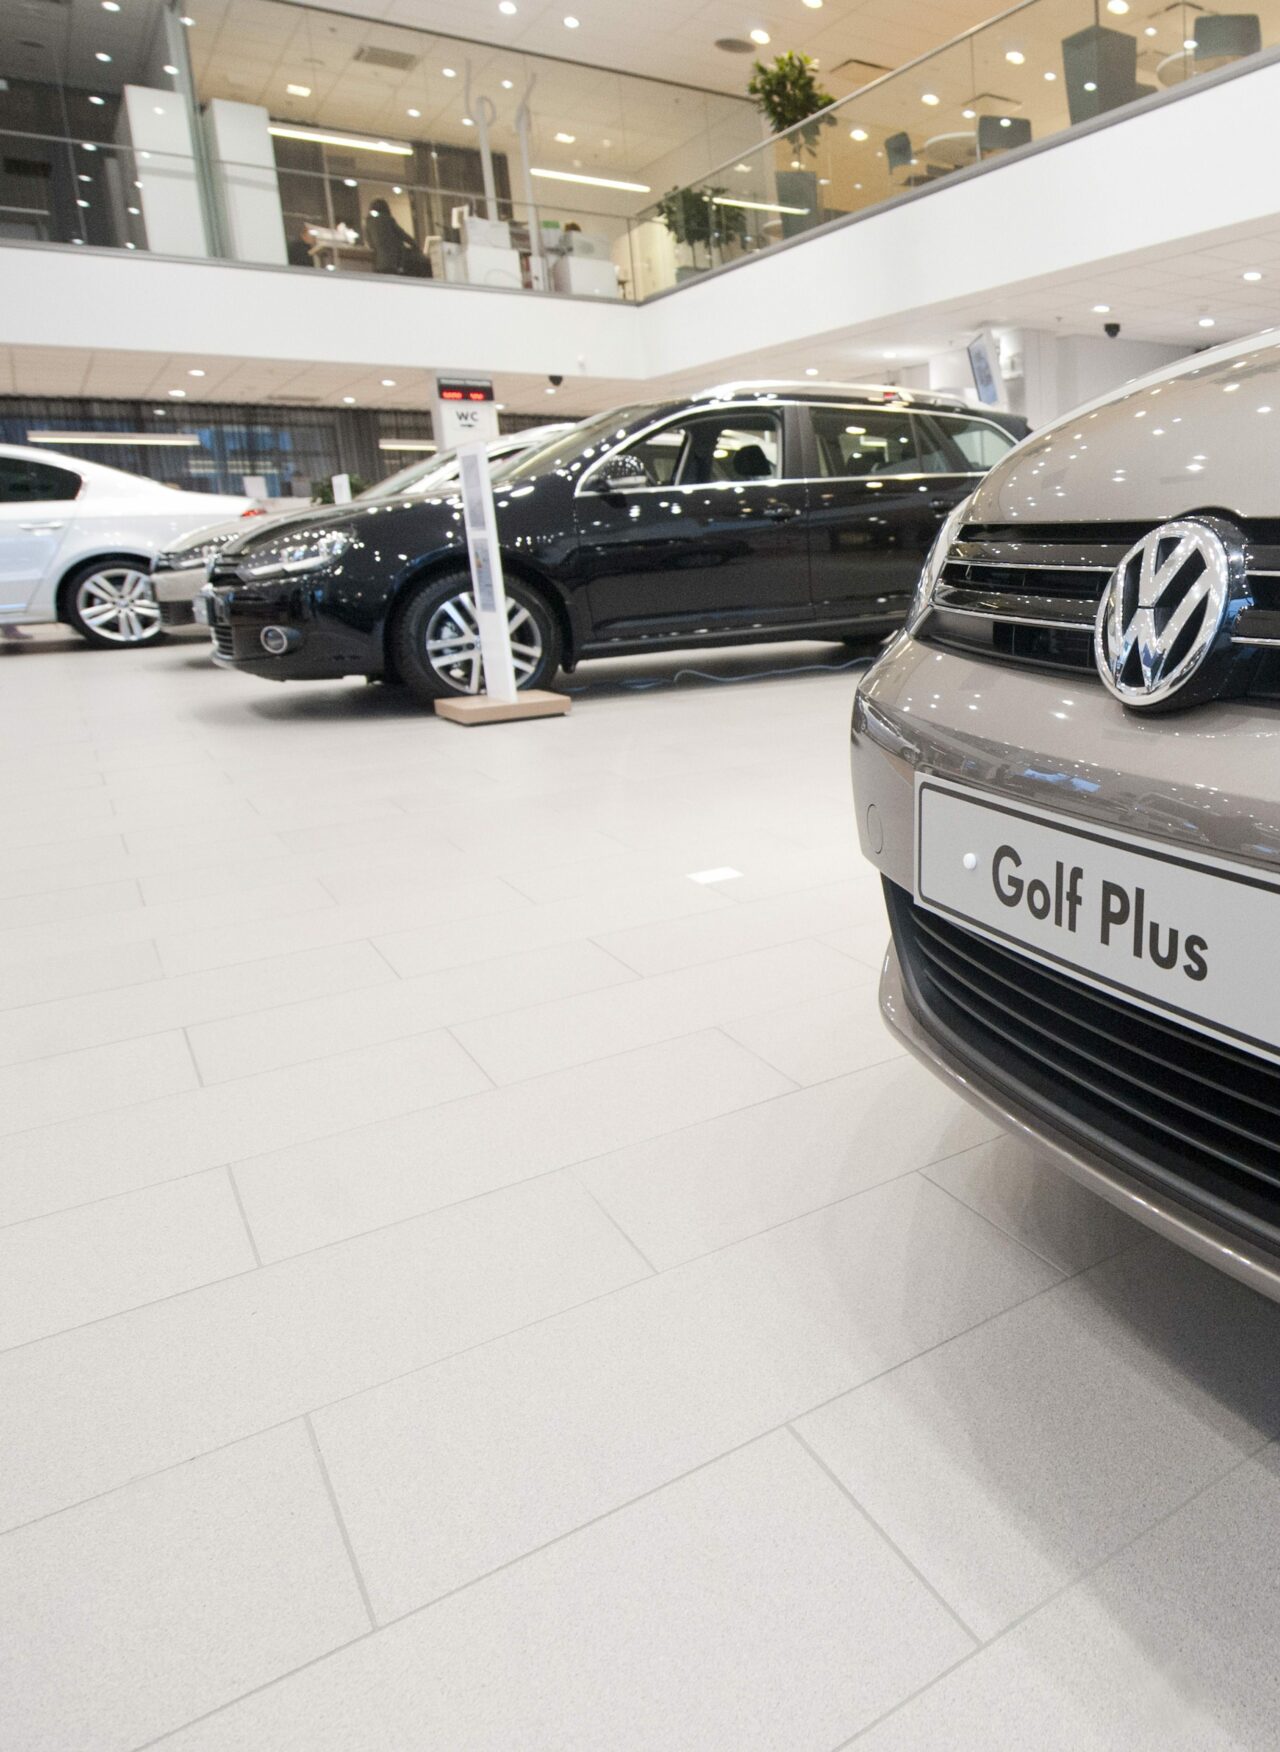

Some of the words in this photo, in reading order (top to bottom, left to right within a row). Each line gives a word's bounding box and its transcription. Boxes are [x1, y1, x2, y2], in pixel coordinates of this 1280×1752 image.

[455, 411, 479, 422] WC
[991, 844, 1084, 933] Golf
[1100, 879, 1209, 982] Plus
